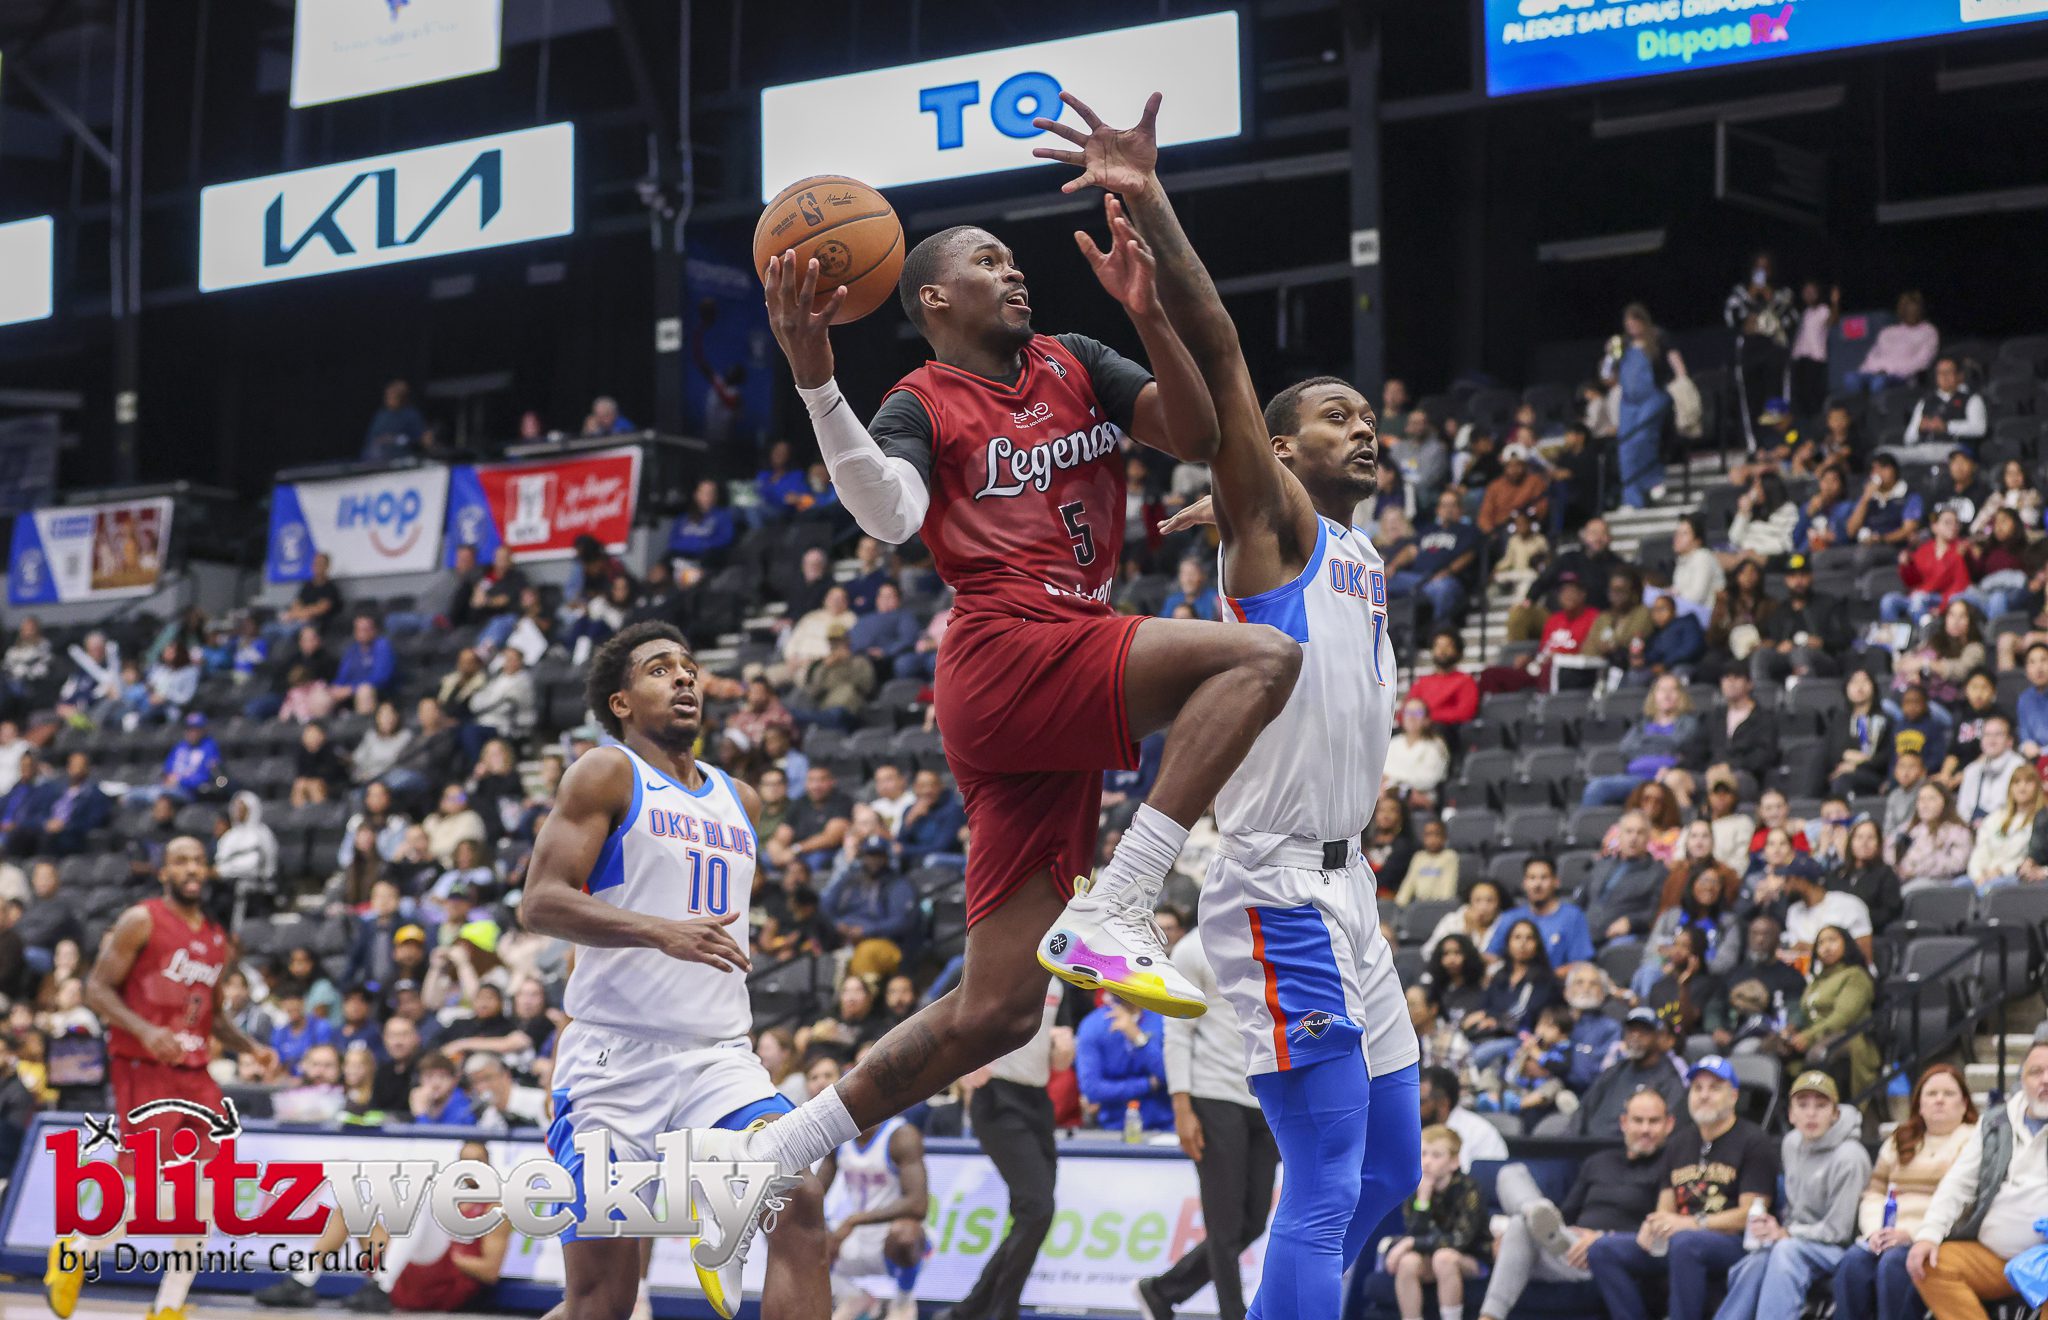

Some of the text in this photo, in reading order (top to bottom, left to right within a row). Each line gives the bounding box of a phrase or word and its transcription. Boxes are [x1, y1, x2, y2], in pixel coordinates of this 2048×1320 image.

[1502, 14, 1576, 45] PLEDGE
[1576, 6, 1625, 34] SAFE
[1625, 0, 1680, 26] DRUG
[919, 71, 1064, 151] TO
[263, 148, 502, 268] KIA
[1057, 500, 1096, 567] 5
[1328, 557, 1369, 601] OK
[649, 807, 755, 861] OKC BLUE
[685, 846, 731, 918] 10
[1303, 1018, 1331, 1027] BLUE
